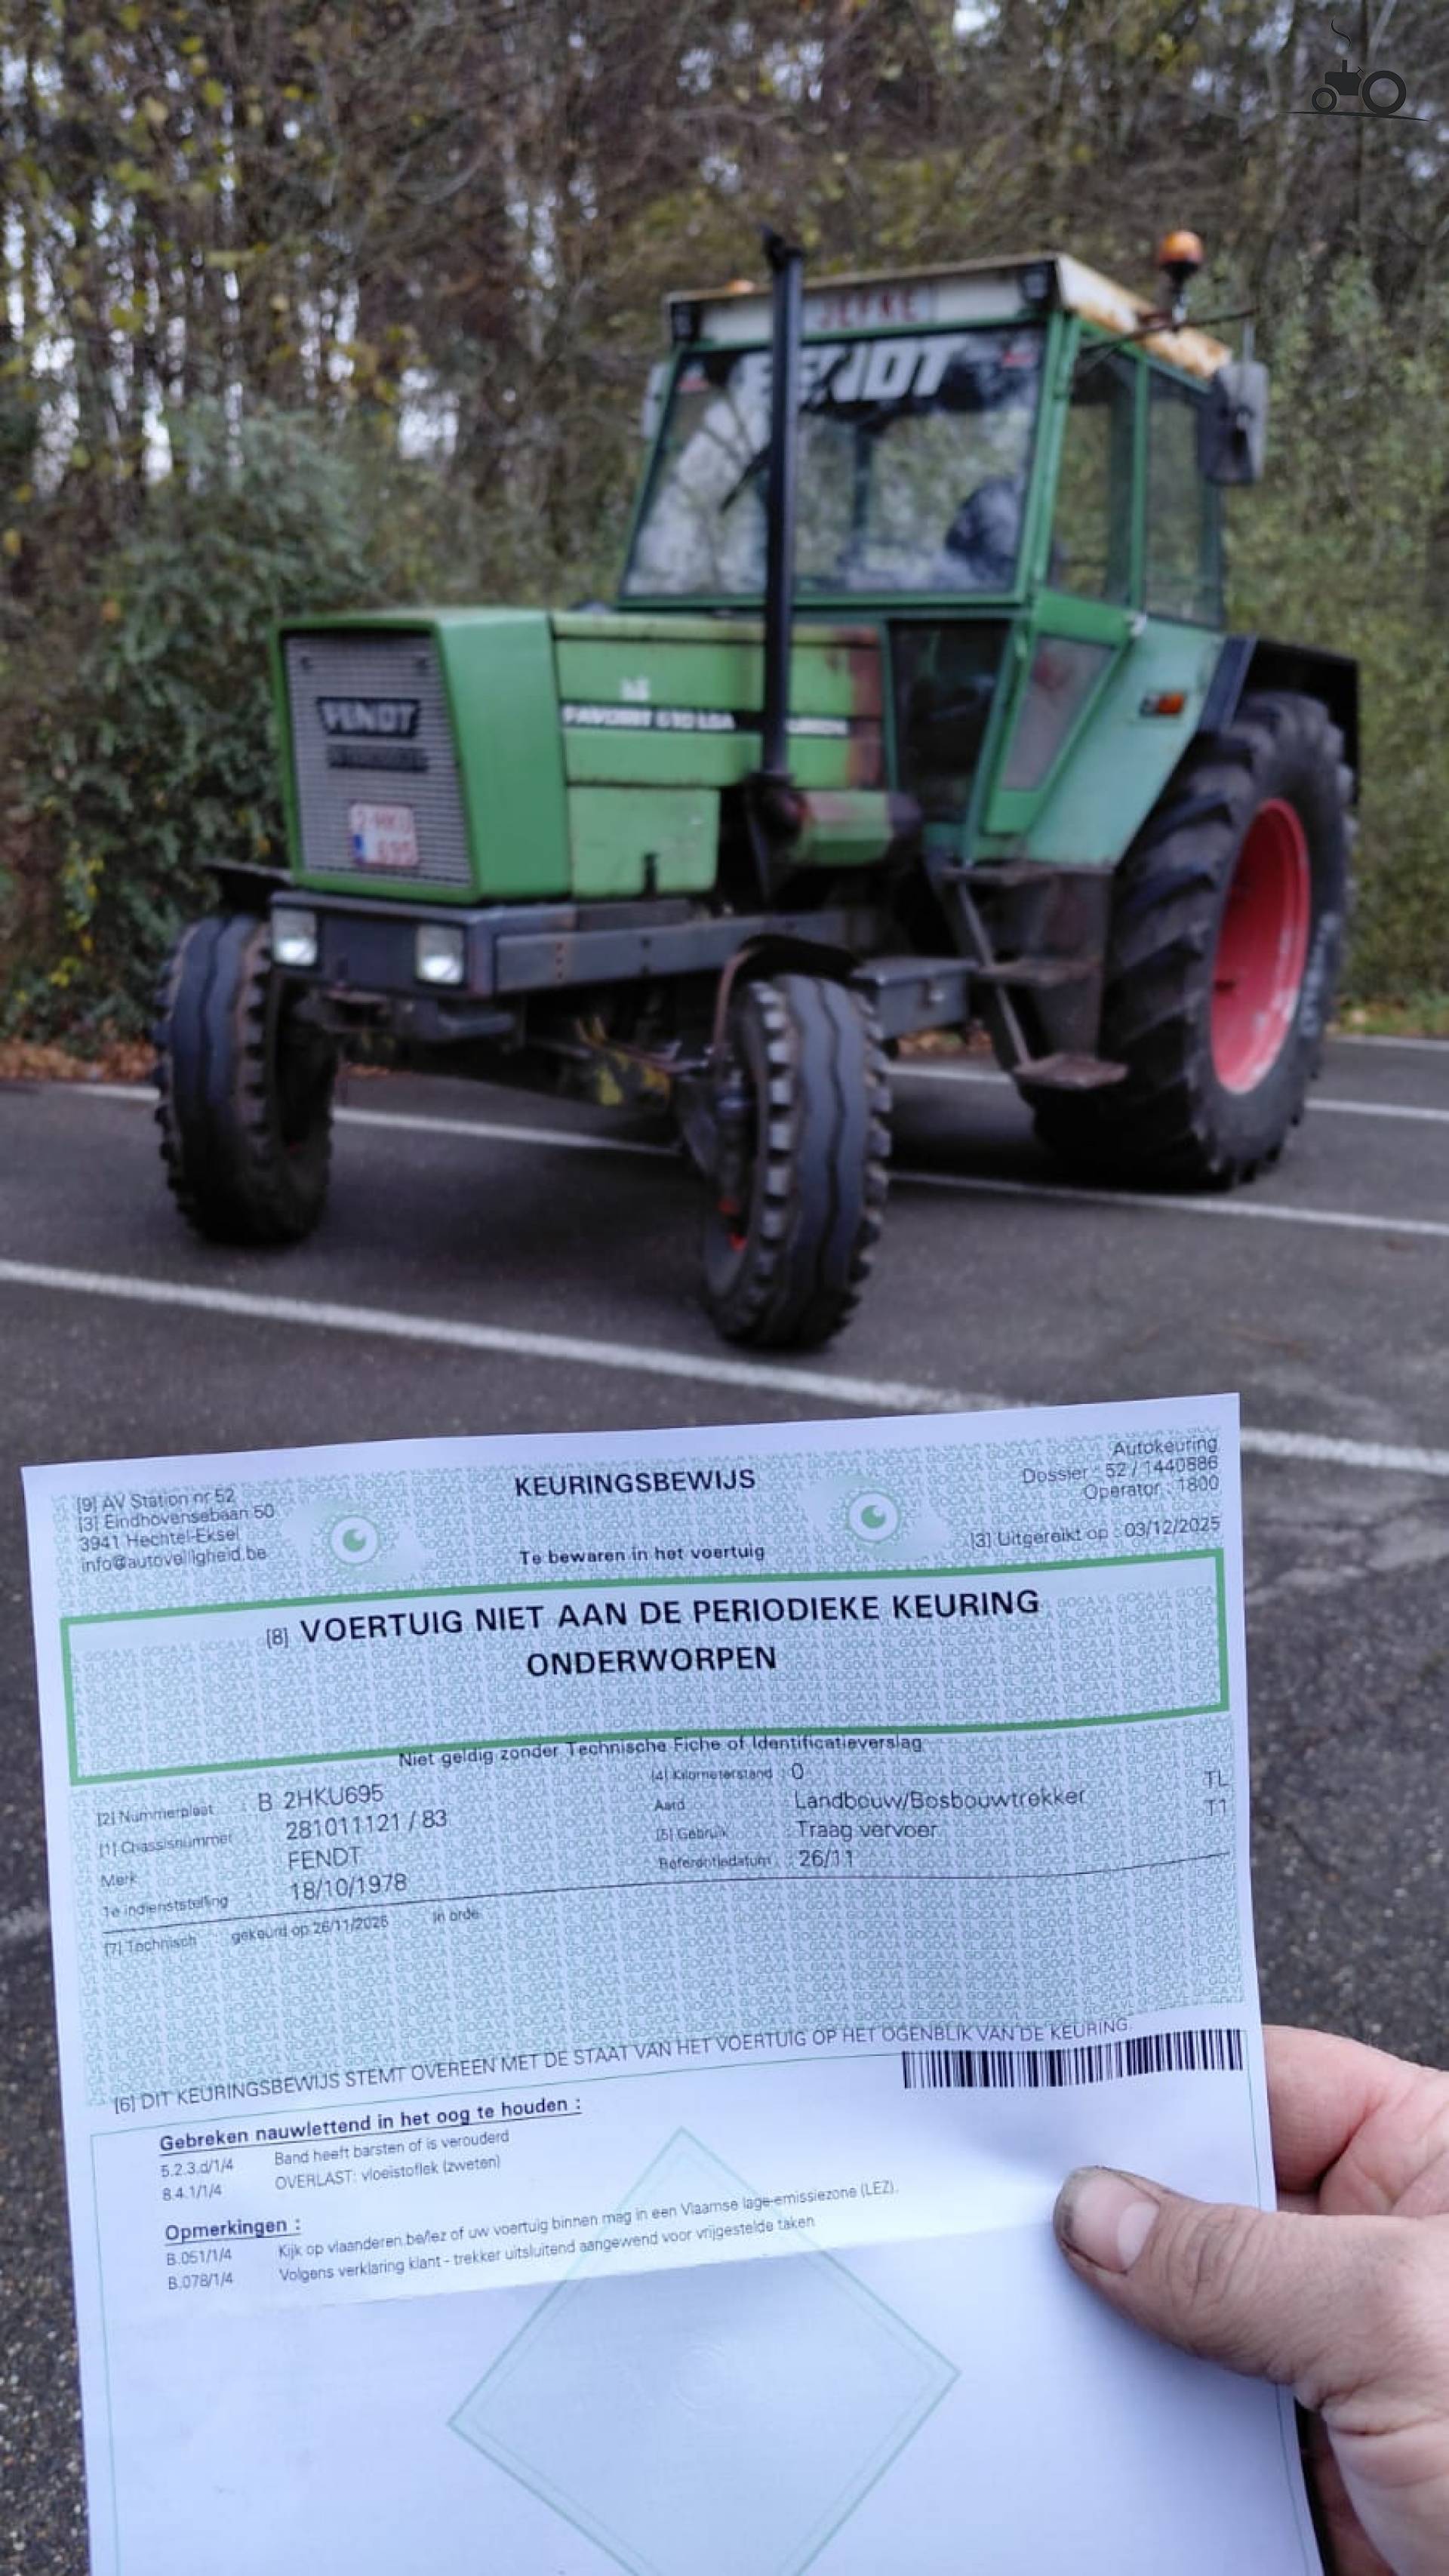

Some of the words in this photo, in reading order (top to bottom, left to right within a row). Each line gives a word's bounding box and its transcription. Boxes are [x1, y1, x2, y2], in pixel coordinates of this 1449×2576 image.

[322, 700, 416, 732] FENDT
[1112, 1437, 1217, 1457] Autokeuring
[515, 1469, 755, 1497] KEURINGSBEWIJS
[1023, 1467, 1088, 1484] Dossier
[1106, 1463, 1126, 1479] 52
[1083, 1482, 1160, 1501] Operator
[1178, 1475, 1219, 1492] 1800
[103, 1496, 125, 1510] AV
[131, 1493, 187, 1510] Station
[193, 1491, 210, 1504] nr
[215, 1488, 234, 1503] 52
[105, 1507, 248, 1530] Eindhovensebaan
[254, 1503, 274, 1519] 50
[80, 1534, 119, 1552] 3941
[127, 1527, 239, 1547] Hechtel-Eksel
[998, 1527, 1081, 1548] Uitgereikt
[1087, 1527, 1108, 1540] op
[1125, 1516, 1220, 1538] 03/12/2025
[82, 1547, 266, 1572] info@autoveiligheid.be
[520, 1551, 541, 1565] Te
[549, 1548, 626, 1564] bewaren
[632, 1547, 648, 1561] in
[655, 1547, 683, 1560] het
[691, 1544, 764, 1562] voertuig
[266, 1628, 288, 1648] [8]
[300, 1611, 463, 1644] VOERTUIG
[475, 1606, 544, 1633] NIET
[558, 1602, 627, 1627] AAN
[641, 1602, 680, 1624] DE
[695, 1597, 879, 1623] PERIODIEKE
[894, 1590, 1040, 1618] KEURING
[528, 1647, 777, 1676] ONDERWORPEN
[398, 1752, 434, 1767] Niet
[441, 1749, 493, 1767] geldig
[500, 1744, 558, 1761] zonder
[568, 1739, 666, 1757] Technische
[675, 1737, 720, 1752] Fiche
[728, 1736, 744, 1750] of
[753, 1734, 922, 1753] Identificatieverslag
[1206, 1771, 1229, 1789] TL
[119, 1805, 213, 1824] Nummerplaat
[259, 1793, 272, 1811] B
[285, 1784, 383, 1809] 2HKU695
[654, 1799, 685, 1811] Aard
[795, 1788, 1086, 1811] Landbouw/Bosbouwtrekker
[121, 1834, 231, 1854] Chassisnummer
[286, 1814, 399, 1840] 281011121
[423, 1810, 446, 1828] 83
[678, 1827, 728, 1840] Gebruik
[796, 1820, 852, 1842] Traag
[859, 1820, 937, 1839] vervoer
[101, 1873, 137, 1887] Merk
[288, 1846, 361, 1871] FENDT
[660, 1854, 771, 1870] Referentiedatum
[799, 1849, 852, 1869] 26/11
[124, 1895, 229, 1917] indienststelling
[292, 1873, 407, 1901] 18/10/1978
[128, 1934, 196, 1953] Technisch
[231, 1925, 287, 1945] gekeurd
[292, 1923, 309, 1937] op
[450, 1908, 478, 1922] orde
[115, 2097, 135, 2113] [6]
[141, 2091, 171, 2110] DIT
[177, 2073, 340, 2105] KEURINGSBEWIJS
[346, 2067, 406, 2087] STEMT
[412, 2060, 495, 2082] OVEREEN
[501, 2054, 540, 2072] MET
[546, 2051, 568, 2068] DE
[574, 2045, 628, 2064] STAAT
[637, 2042, 672, 2059] VAN
[677, 2039, 711, 2054] HET
[717, 2031, 807, 2051] VOERTUIG
[812, 2029, 836, 2045] OP
[842, 2028, 875, 2043] HET
[882, 2025, 971, 2042] OGENBLIK
[978, 2026, 1015, 2041] VAN
[1018, 2024, 1044, 2039] DE
[160, 2130, 248, 2151] Gebreken
[256, 2116, 371, 2141] nauwlettend
[378, 2113, 393, 2128] in
[401, 2110, 429, 2126] het
[437, 2109, 469, 2125] oog
[478, 2105, 494, 2119] te
[501, 2097, 567, 2117] houden
[160, 2159, 234, 2177] 5.2.3.d/1/4
[275, 2150, 309, 2165] Band
[314, 2146, 349, 2162] heeft
[354, 2141, 405, 2158] barsten
[409, 2137, 422, 2153] of
[426, 2135, 437, 2150] is
[441, 2130, 509, 2148] verouderd
[162, 2184, 222, 2202] 8.4.1/1/4
[275, 2169, 358, 2190] OVERLAST:
[361, 2161, 438, 2182] vloeistoflek
[444, 2154, 501, 2173] (zweten)
[166, 2219, 287, 2245] Opmerkingen
[167, 2247, 232, 2266] B.051/1/4
[279, 2243, 300, 2258] Kijk
[307, 2244, 323, 2257] op
[328, 2230, 448, 2253] vlaanderen.be/lez
[451, 2227, 464, 2242] of
[468, 2226, 489, 2238] uw
[494, 2218, 548, 2236] voertuig
[552, 2212, 598, 2230] binnen
[603, 2209, 631, 2226] mag
[636, 2206, 647, 2221] in
[652, 2205, 676, 2219] een
[681, 2199, 738, 2217] Vlaamse
[743, 2186, 857, 2211] lage-emissiezone
[168, 2272, 234, 2291] B.078/1/4
[279, 2267, 334, 2285] Volgens
[338, 2259, 405, 2279] verklaring
[410, 2254, 441, 2270] klant
[454, 2248, 500, 2265] trekker
[505, 2240, 575, 2261] uitsluitend
[580, 2232, 657, 2255] aangewend
[662, 2228, 691, 2243] voor
[697, 2221, 774, 2242] vrijgestelde
[777, 2215, 814, 2230] taken
